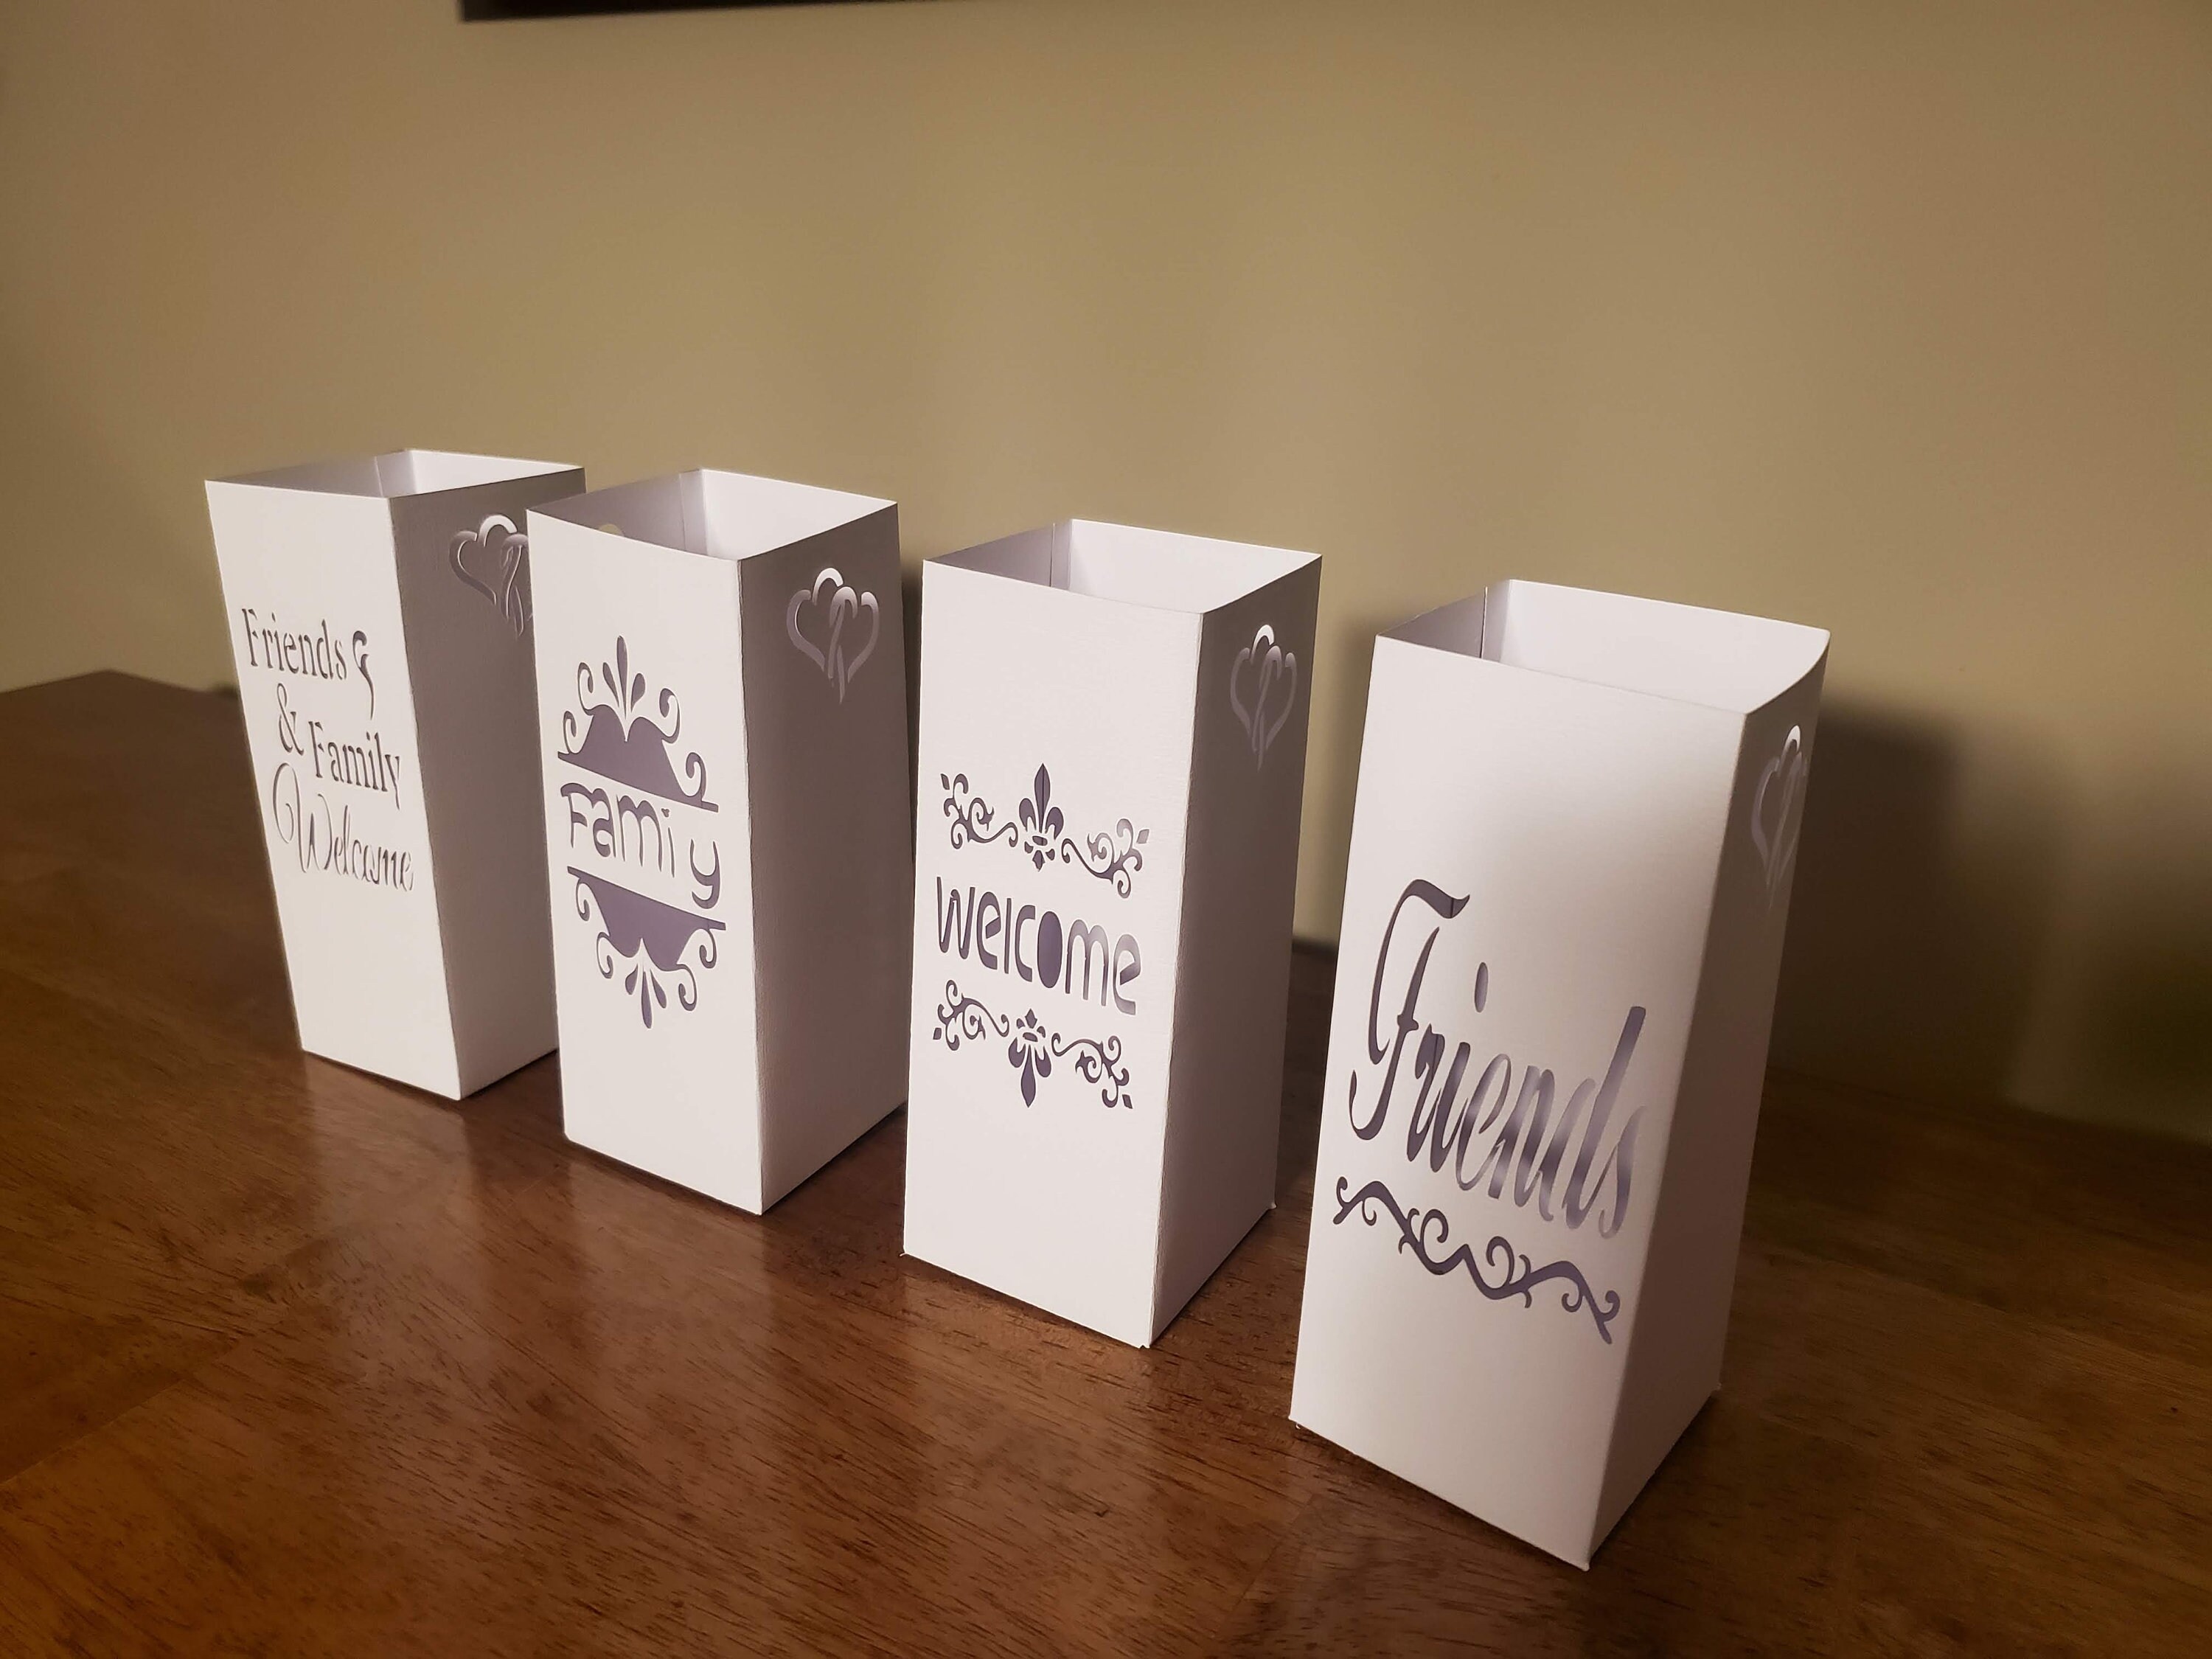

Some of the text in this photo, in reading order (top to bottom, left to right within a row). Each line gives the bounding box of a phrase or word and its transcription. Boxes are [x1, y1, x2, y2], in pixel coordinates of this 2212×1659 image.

[242, 608, 347, 681] Friends
[277, 683, 401, 810] & Family
[274, 762, 414, 892] Welcome
[1349, 879, 1646, 1239] Friends
